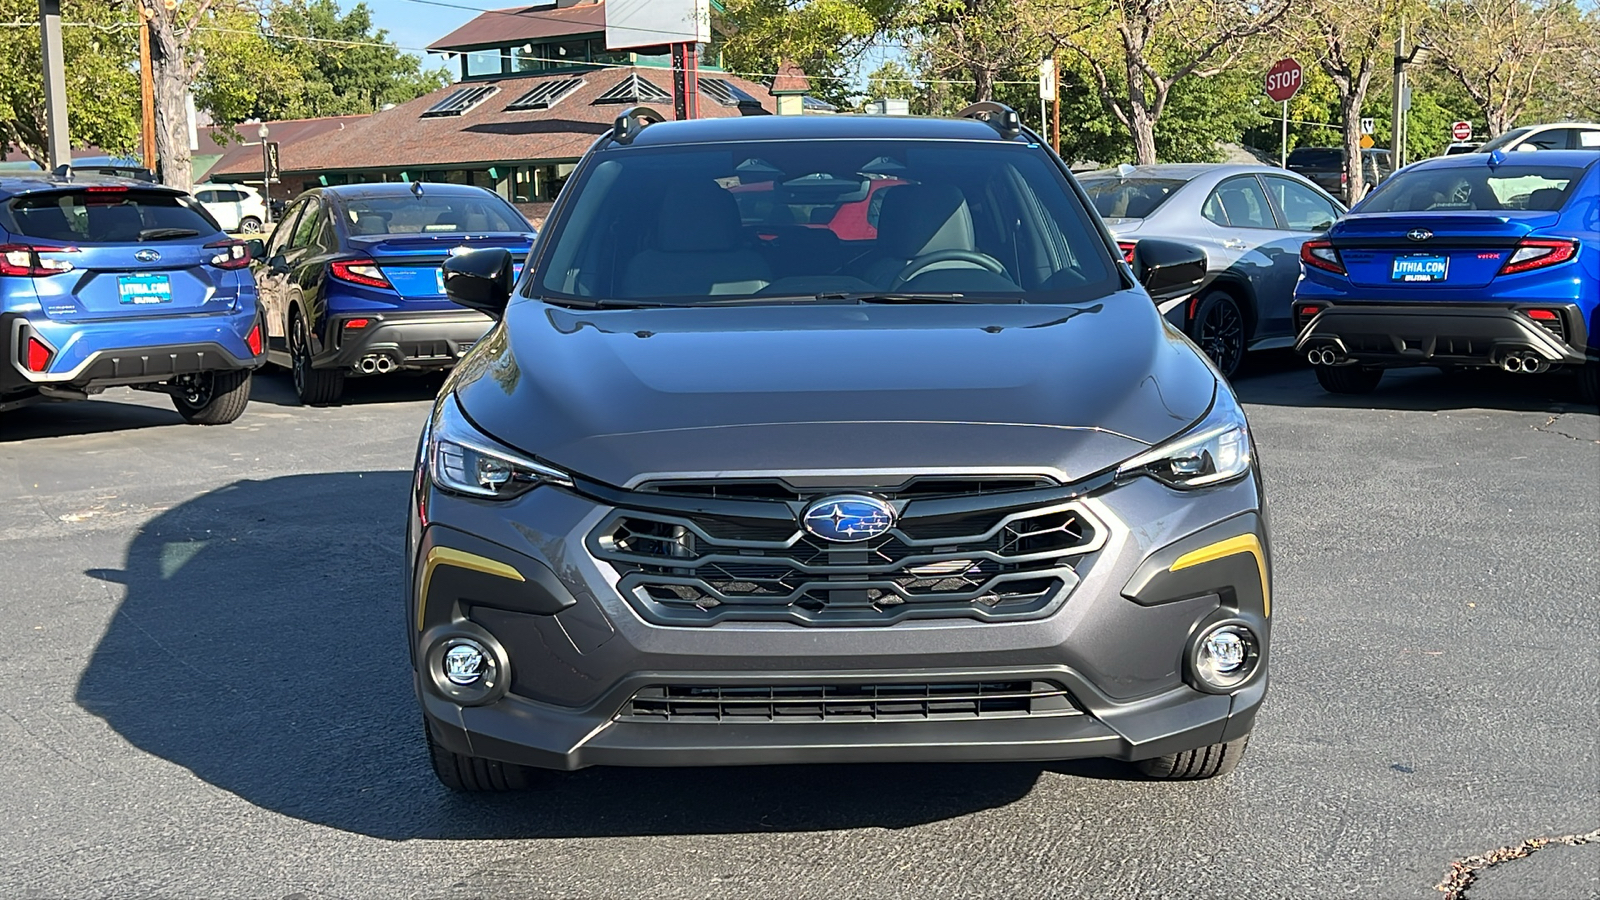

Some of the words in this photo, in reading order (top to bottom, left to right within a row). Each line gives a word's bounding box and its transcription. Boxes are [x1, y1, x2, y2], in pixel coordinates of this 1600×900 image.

[1267, 69, 1300, 91] STOP
[1394, 262, 1446, 273] LITHIA.COM
[119, 282, 170, 295] LITHIA.COM
